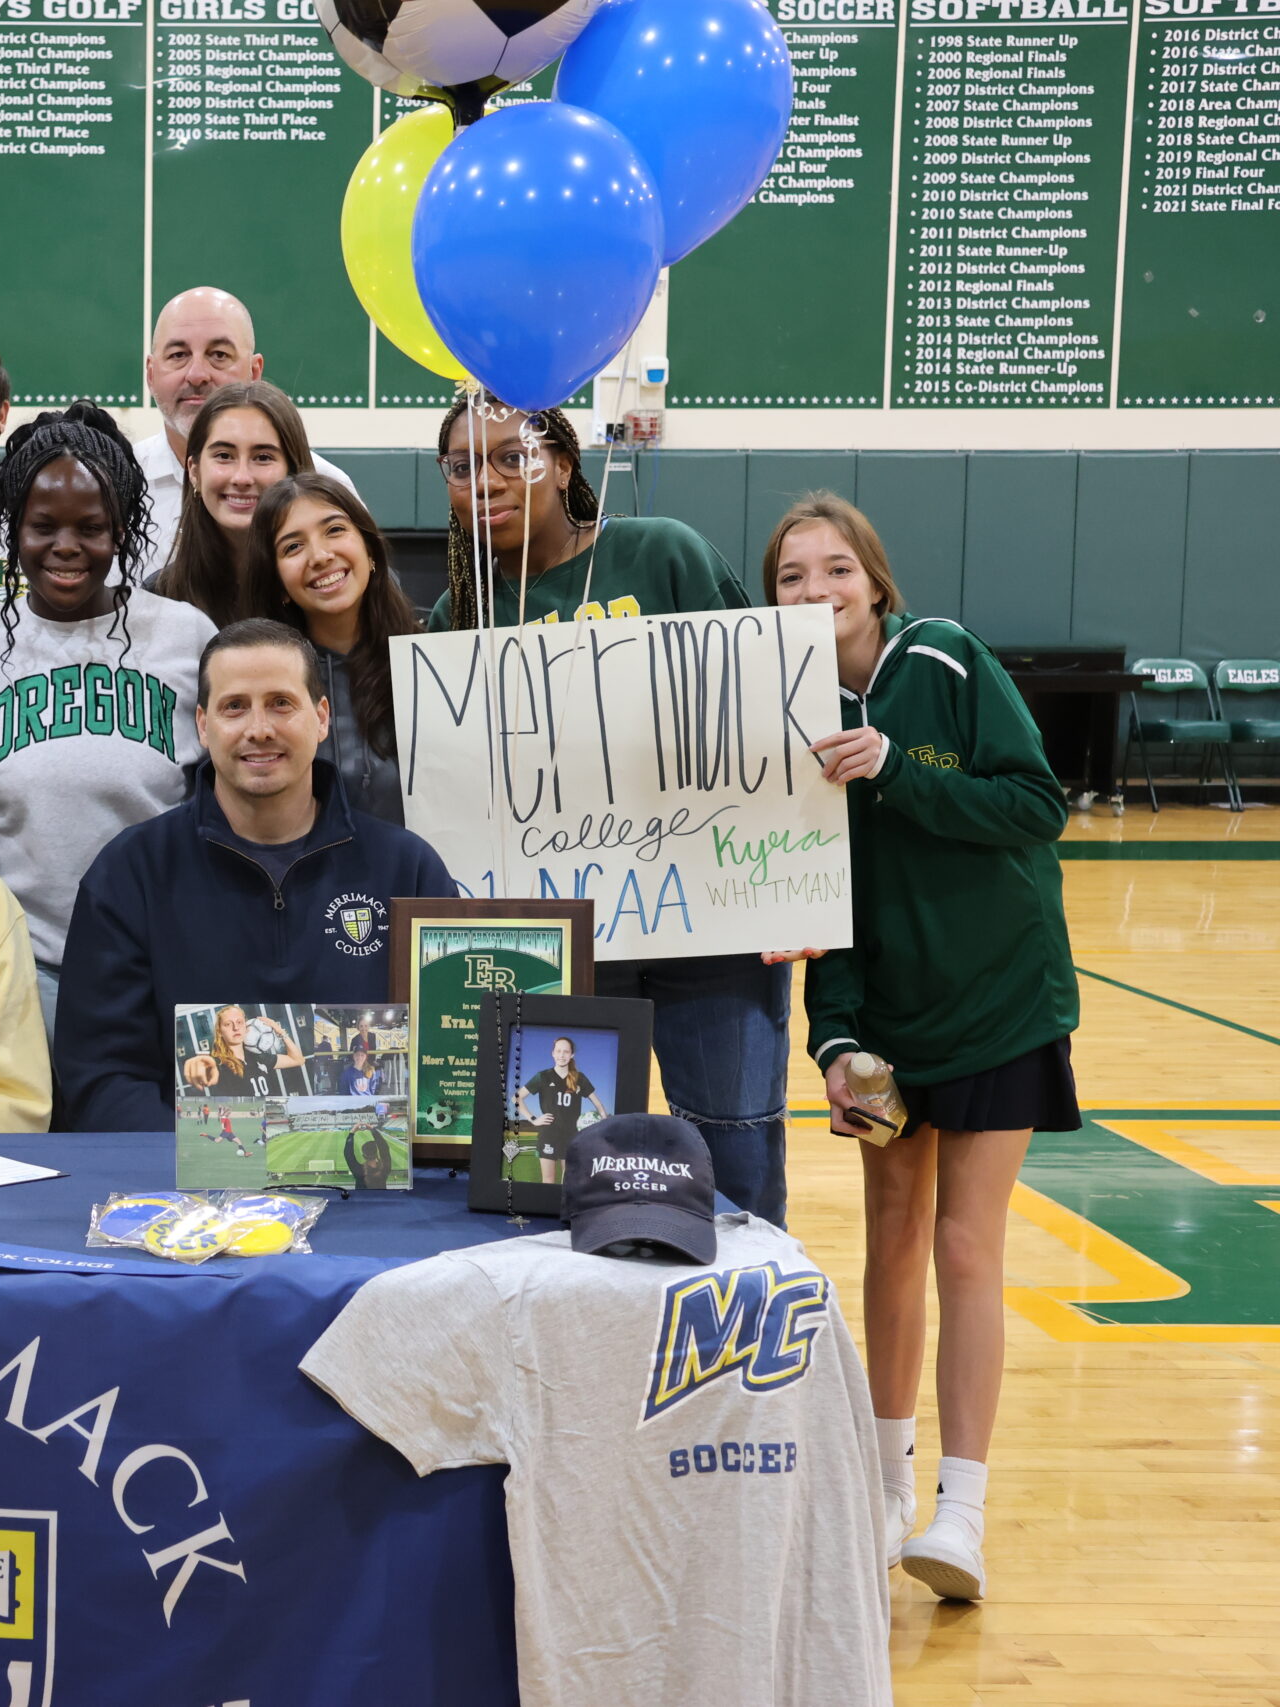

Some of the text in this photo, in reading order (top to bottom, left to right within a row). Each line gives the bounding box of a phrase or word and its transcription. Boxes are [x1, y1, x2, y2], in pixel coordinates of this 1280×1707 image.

[43, 0, 140, 20] GOLF
[160, 0, 265, 20] GIRLS
[777, 0, 895, 21] SOCCER
[910, 0, 1128, 20] SOFTBALL
[30, 33, 106, 47] Champions
[784, 32, 859, 46] Champions
[931, 35, 1078, 48] 1998 State Runner Up
[37, 47, 112, 61] Champions
[168, 49, 334, 63] 2005 District Champions
[16, 63, 50, 74] Third
[54, 63, 90, 75] Place
[1162, 63, 1256, 76] 2017 District
[802, 81, 832, 93] Four
[927, 83, 1094, 97] 2007 District Champions
[814, 114, 860, 126] Finalist
[205, 128, 240, 140] State
[244, 128, 286, 139] Fourth
[291, 129, 326, 140] Place
[787, 146, 863, 160] Champions
[1156, 166, 1265, 179] 2019 Final Four
[1154, 199, 1263, 212] 2021 State Final
[916, 347, 1105, 362] 2014 Regional Champions
[914, 380, 1103, 395] 2015 Co-District Champions
[1227, 669, 1280, 684] EAGLES
[712, 825, 840, 885] Kyra
[324, 892, 387, 921] MERRIMACK
[335, 938, 384, 957] COLLEGE
[250, 1075, 269, 1096] 10
[557, 1091, 572, 1107] 10
[590, 1156, 694, 1180] MERRIMACK
[614, 1181, 667, 1192] SOCCER
[23, 1256, 115, 1269] COLLEGE
[669, 1441, 798, 1478] SOCCER
